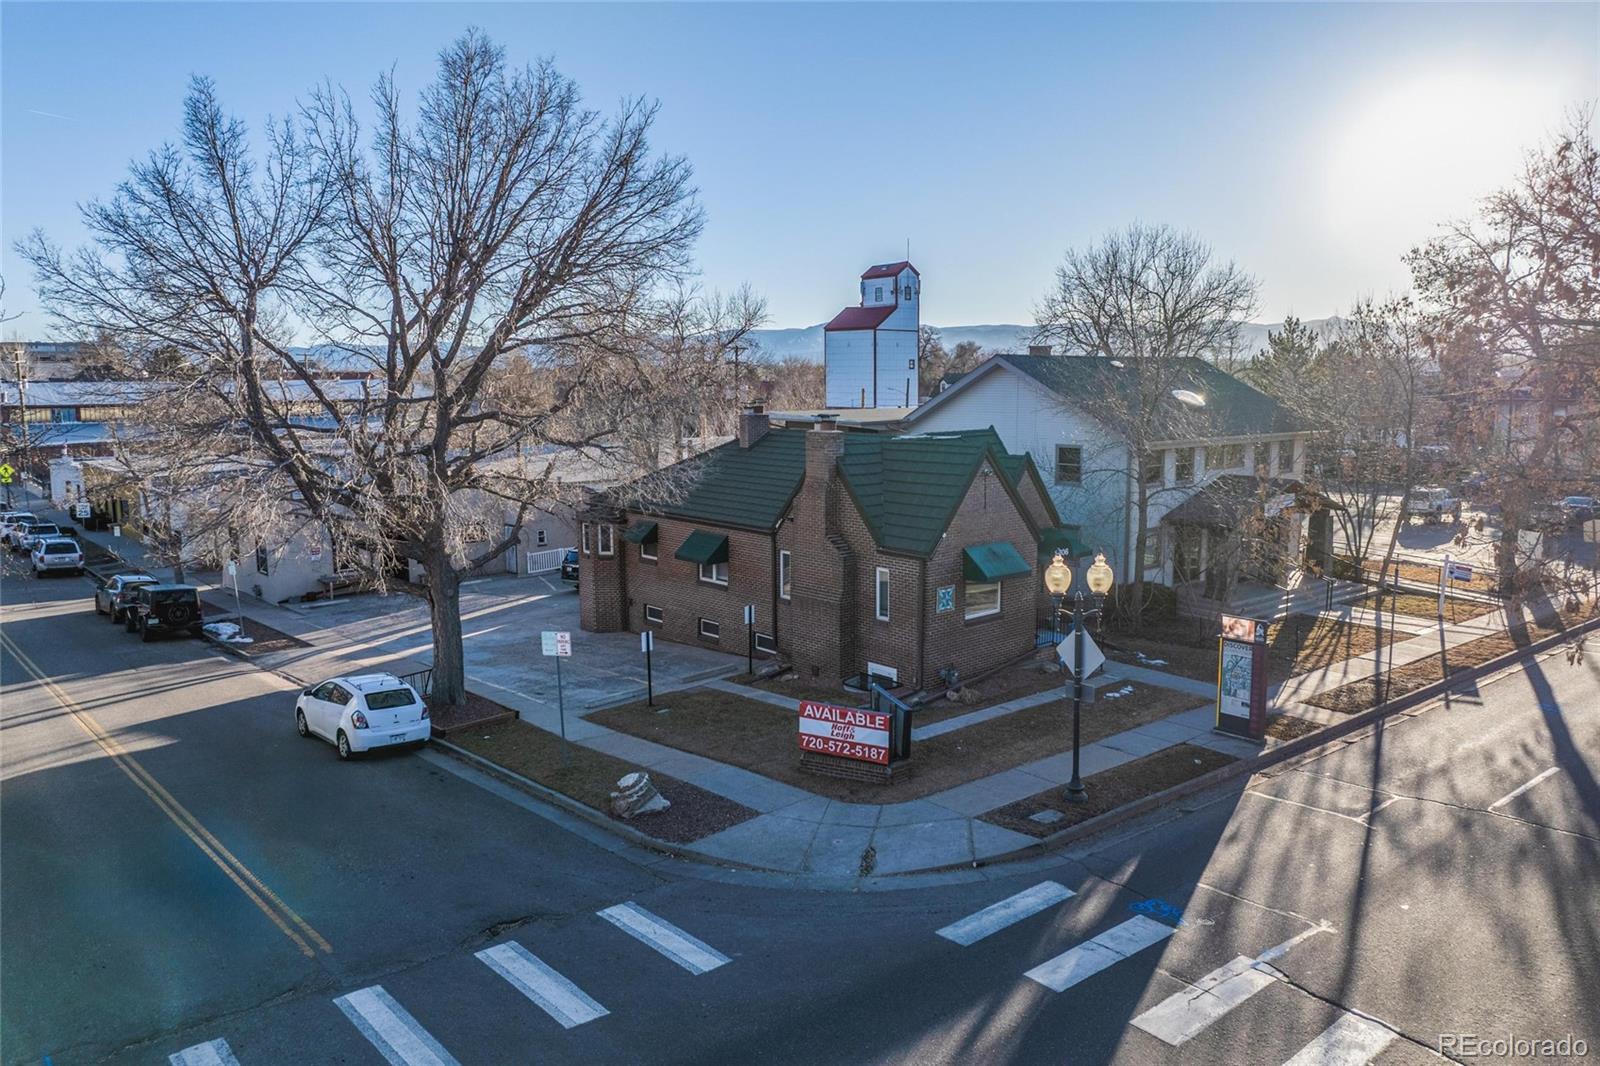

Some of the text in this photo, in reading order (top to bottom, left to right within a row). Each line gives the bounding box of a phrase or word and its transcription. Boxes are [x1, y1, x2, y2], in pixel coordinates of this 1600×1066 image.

[803, 704, 886, 729] AVAILABLE
[801, 735, 886, 760] 720-572-5187
[831, 730, 855, 740] Leigh
